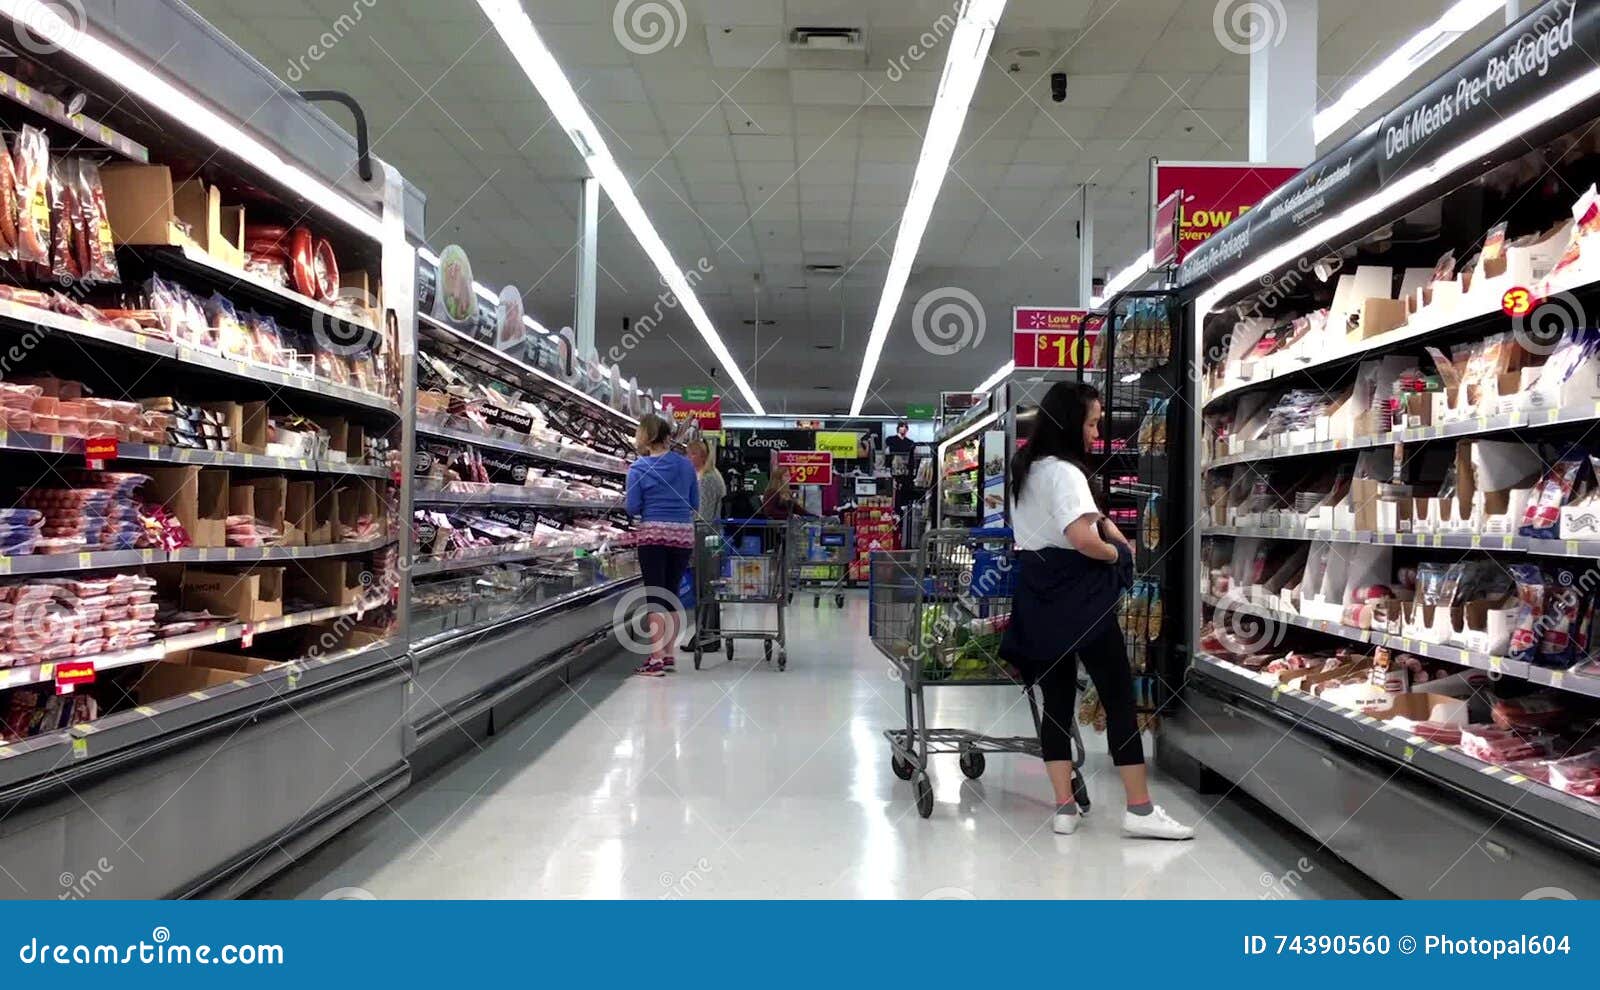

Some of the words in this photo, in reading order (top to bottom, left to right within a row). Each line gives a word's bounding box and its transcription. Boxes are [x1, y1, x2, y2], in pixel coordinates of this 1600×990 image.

[1385, 113, 1410, 160] Deli
[1411, 93, 1454, 144] Meats
[1455, 1, 1576, 116] Pre-Packaged
[1179, 205, 1232, 228] Low
[1504, 290, 1530, 313] $3
[1048, 314, 1069, 325] Low
[480, 404, 499, 417] oned
[501, 410, 531, 427] Seafood
[673, 410, 688, 419] ow
[489, 509, 520, 526] Seafood
[537, 513, 562, 530] Poultry
